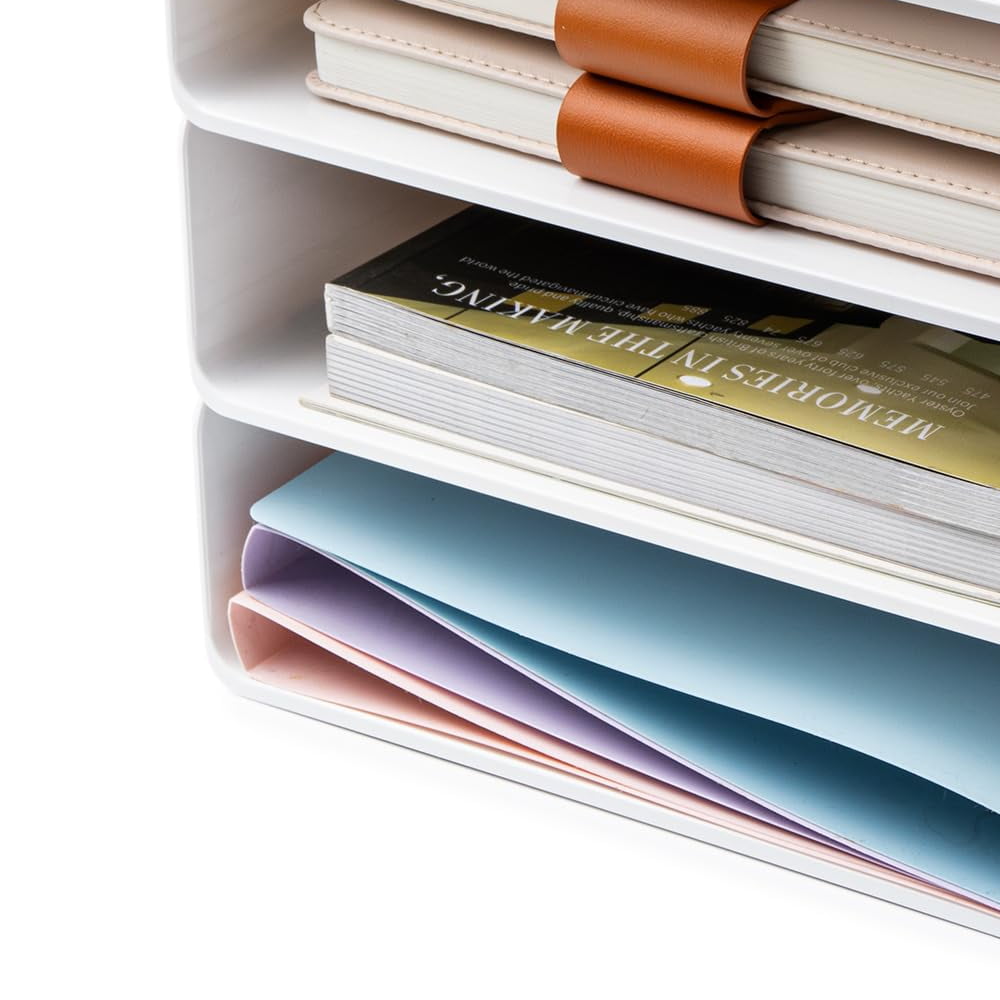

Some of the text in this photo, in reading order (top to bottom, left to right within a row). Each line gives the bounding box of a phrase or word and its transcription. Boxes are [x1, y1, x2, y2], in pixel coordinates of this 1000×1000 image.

[543, 290, 570, 306] and
[574, 296, 614, 314] quality
[458, 256, 976, 411] Join our exclusive club of over seventy yachts who have circumnavigated the world
[708, 334, 749, 352] British
[750, 346, 767, 355] of
[432, 274, 944, 440] MEMORIES IN THE MAKING,
[766, 350, 803, 365] years
[804, 361, 836, 377] forty
[962, 386, 990, 400] 475
[919, 399, 966, 418] Oyster
